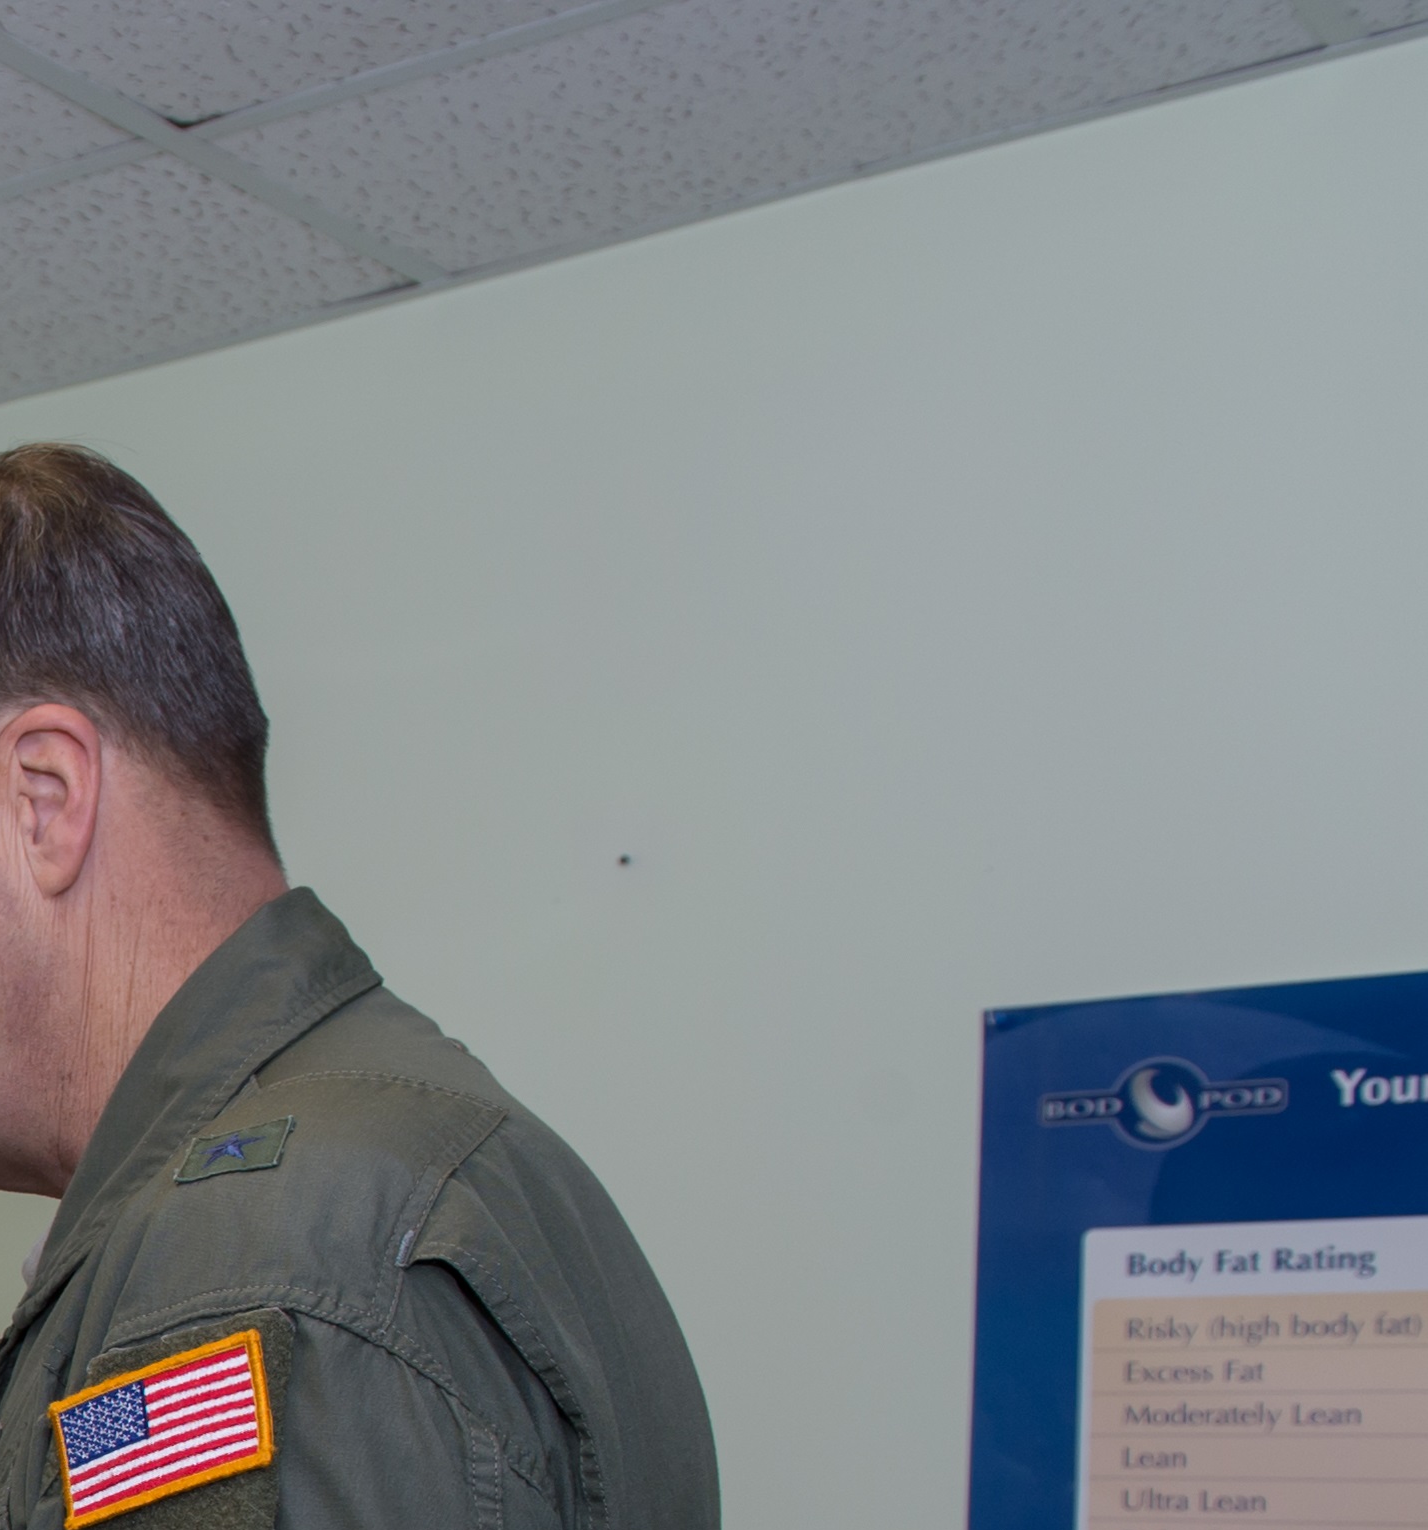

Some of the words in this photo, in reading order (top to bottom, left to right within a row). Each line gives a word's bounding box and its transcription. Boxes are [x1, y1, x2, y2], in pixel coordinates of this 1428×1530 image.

[1044, 1097, 1123, 1120] BOD
[1199, 1086, 1283, 1109] POD
[1126, 1250, 1203, 1282] Body
[1215, 1250, 1261, 1274] Fat
[1272, 1245, 1377, 1278] Rating
[1126, 1316, 1199, 1347] Risky
[1208, 1314, 1280, 1346] (high
[1290, 1312, 1365, 1343] body
[1374, 1311, 1423, 1338] fat)
[1124, 1359, 1214, 1384] Excess
[1224, 1359, 1264, 1383] Fat
[1124, 1402, 1282, 1433] Moderately
[1293, 1402, 1363, 1427] Lean
[1122, 1447, 1187, 1469] Lean
[1122, 1488, 1189, 1511] Ultra
[1199, 1489, 1268, 1513] Lean
